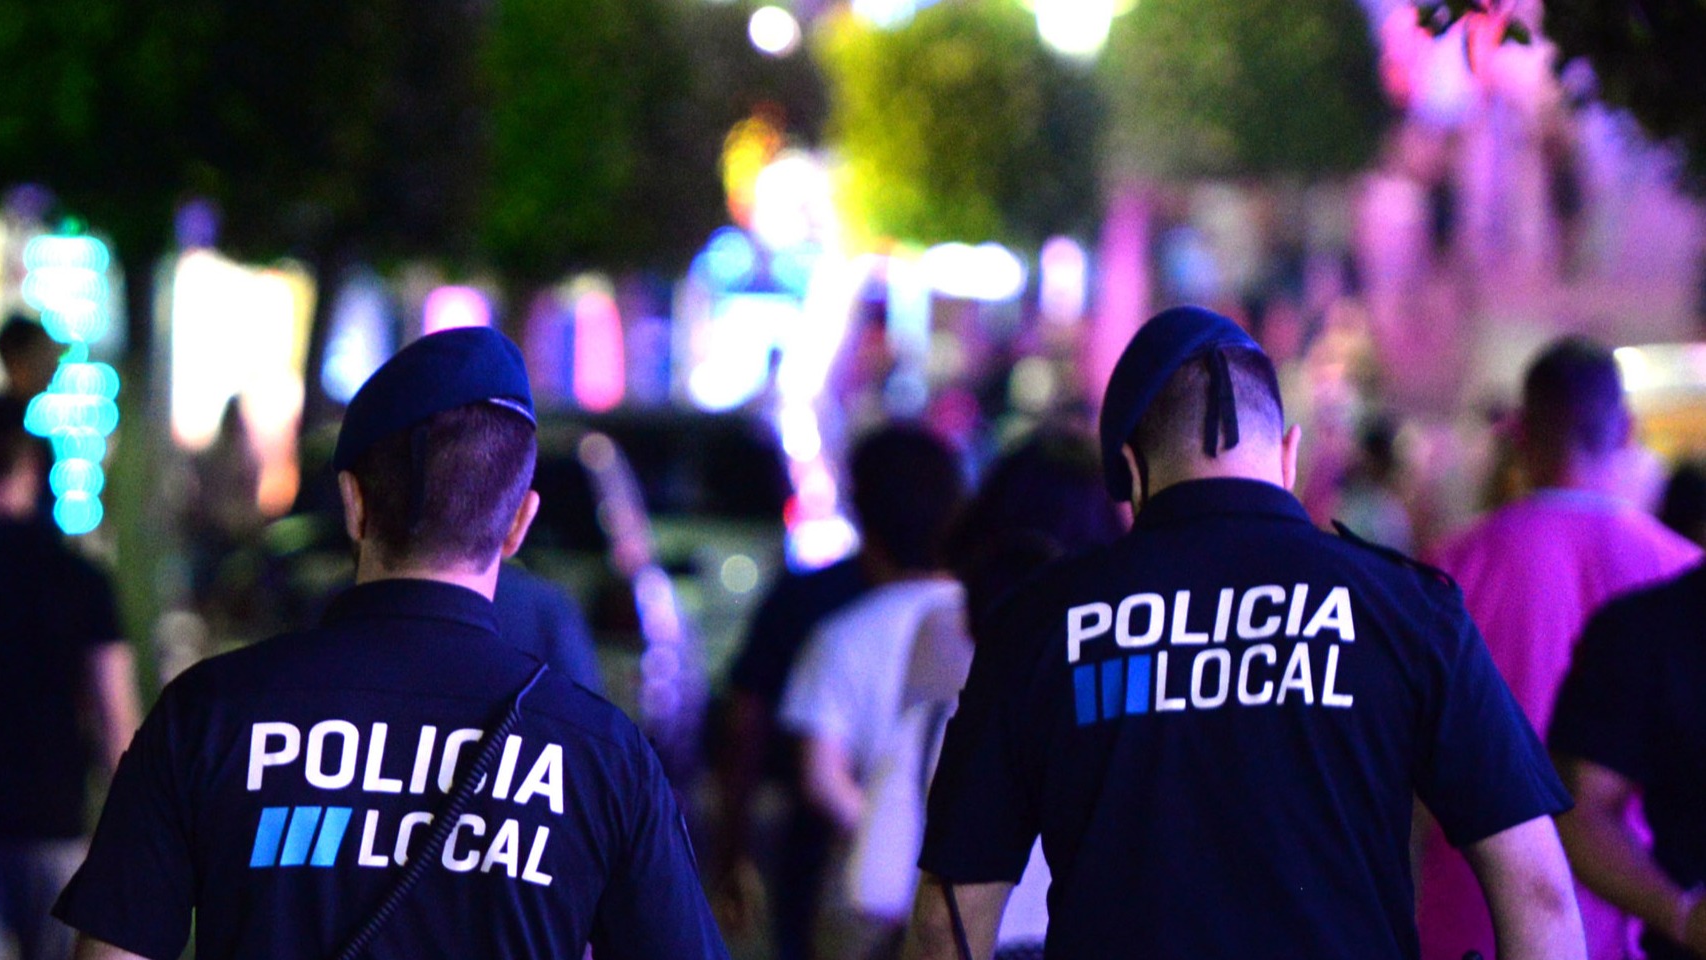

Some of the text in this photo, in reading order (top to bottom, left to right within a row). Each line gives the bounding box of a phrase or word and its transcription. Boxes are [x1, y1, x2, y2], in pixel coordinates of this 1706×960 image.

[1067, 583, 1356, 664] POLICIA
[1155, 641, 1355, 712] LOCAL
[246, 719, 565, 815] POLICIA
